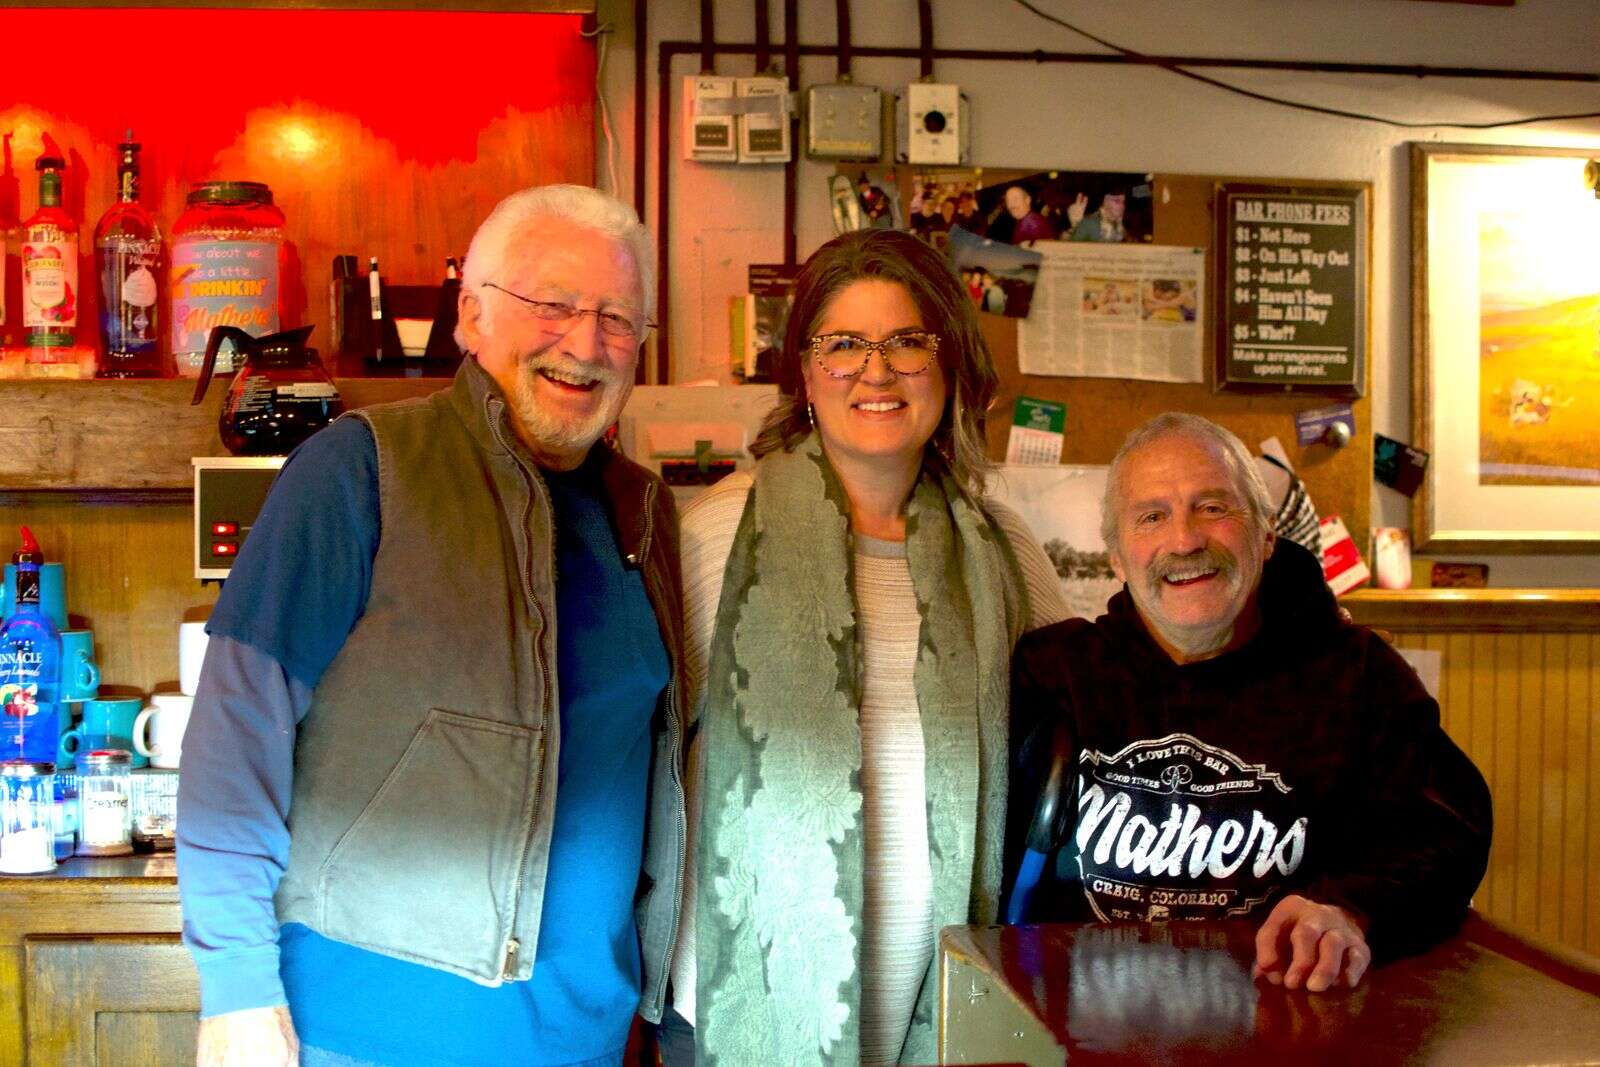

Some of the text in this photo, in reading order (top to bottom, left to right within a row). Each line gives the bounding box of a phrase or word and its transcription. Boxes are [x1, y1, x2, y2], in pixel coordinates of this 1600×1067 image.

[1236, 201, 1350, 224] BAR PHONE FEES
[1236, 227, 1250, 242] $1
[1260, 227, 1280, 243] Not
[1283, 228, 1311, 244] Here
[1260, 248, 1276, 263] On
[1278, 248, 1299, 264] His
[1301, 249, 1325, 269] Way
[1327, 250, 1349, 266] Out
[1259, 267, 1284, 284] Just
[1286, 269, 1310, 285] Left
[1259, 287, 1303, 304] Haven't
[1305, 289, 1333, 305] Seen
[1258, 304, 1328, 325] Him All Day
[1233, 350, 1348, 365] Make arrangements
[1253, 364, 1284, 376] upon
[1126, 744, 1231, 776] I LOVE THIS BAR
[1105, 771, 1160, 789] GOOD TIMES
[1190, 779, 1255, 793] GOOD FRIENDS
[1077, 783, 1308, 879] Mathers
[1093, 879, 1229, 906] CRAIG, COLORADO
